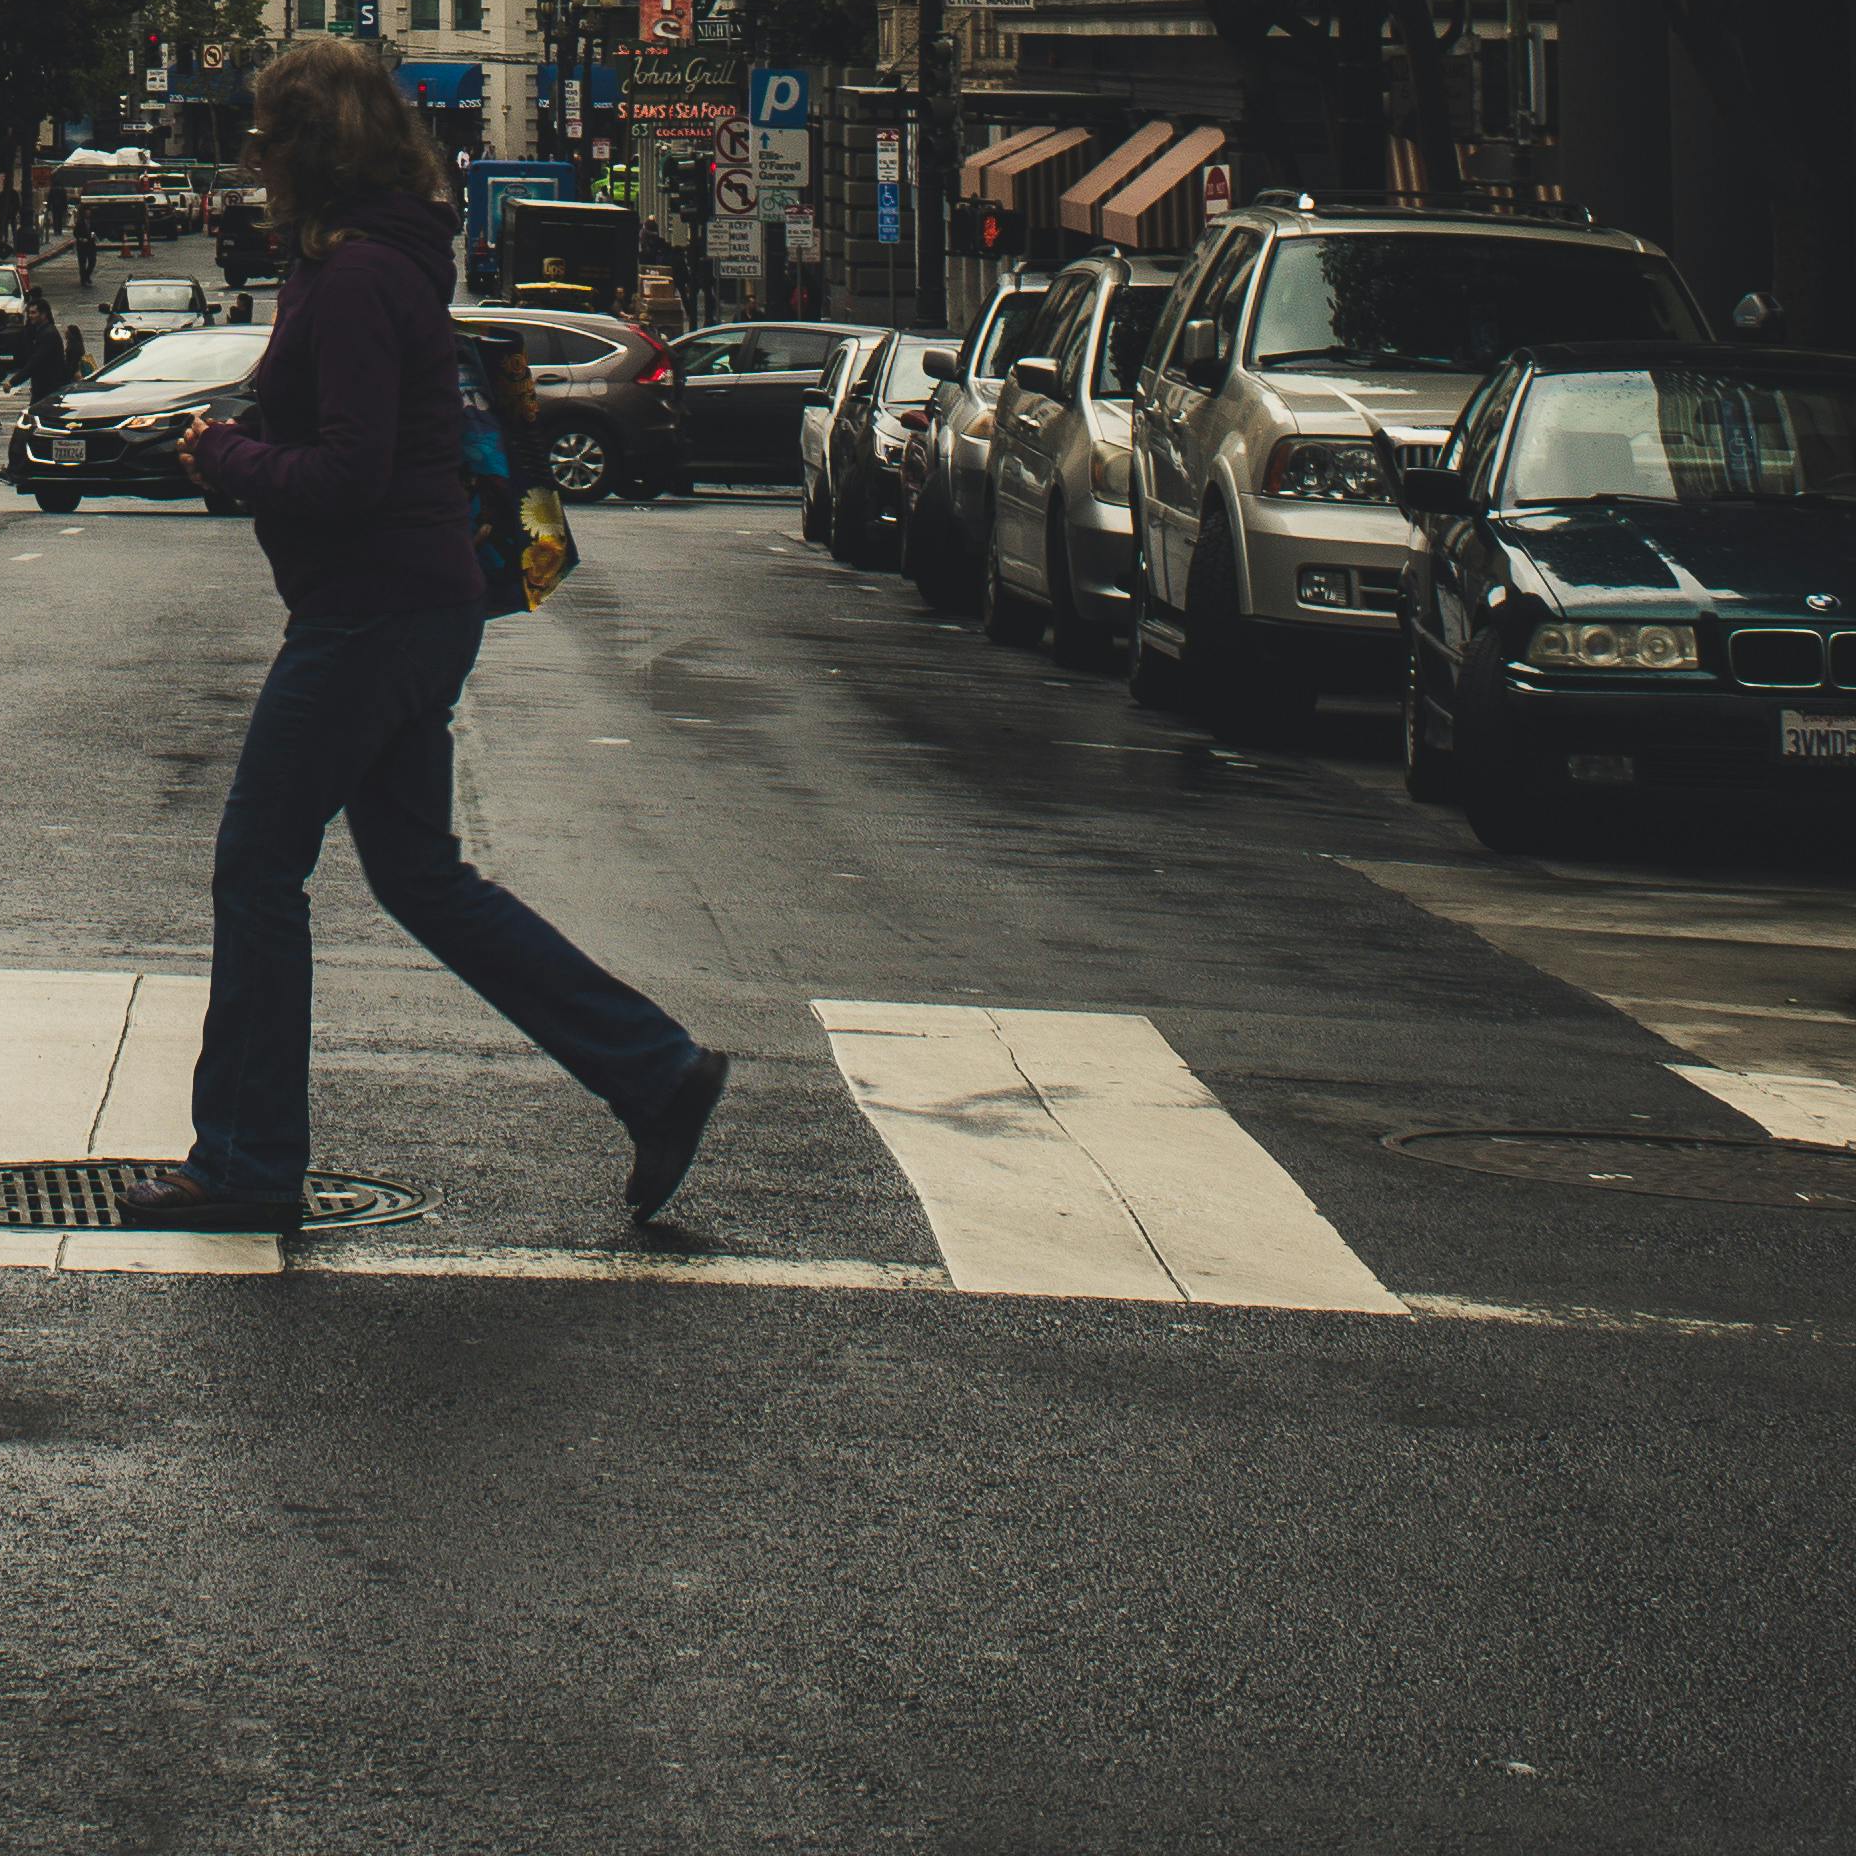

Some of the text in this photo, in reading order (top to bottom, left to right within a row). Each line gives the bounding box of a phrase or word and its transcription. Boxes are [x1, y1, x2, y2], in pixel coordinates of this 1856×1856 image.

[618, 102, 666, 120] SEAKS
[655, 127, 713, 138] COCKTAILS
[759, 161, 802, 171] O'Farrell
[758, 171, 795, 182] Garage
[729, 222, 755, 230] XCEPT
